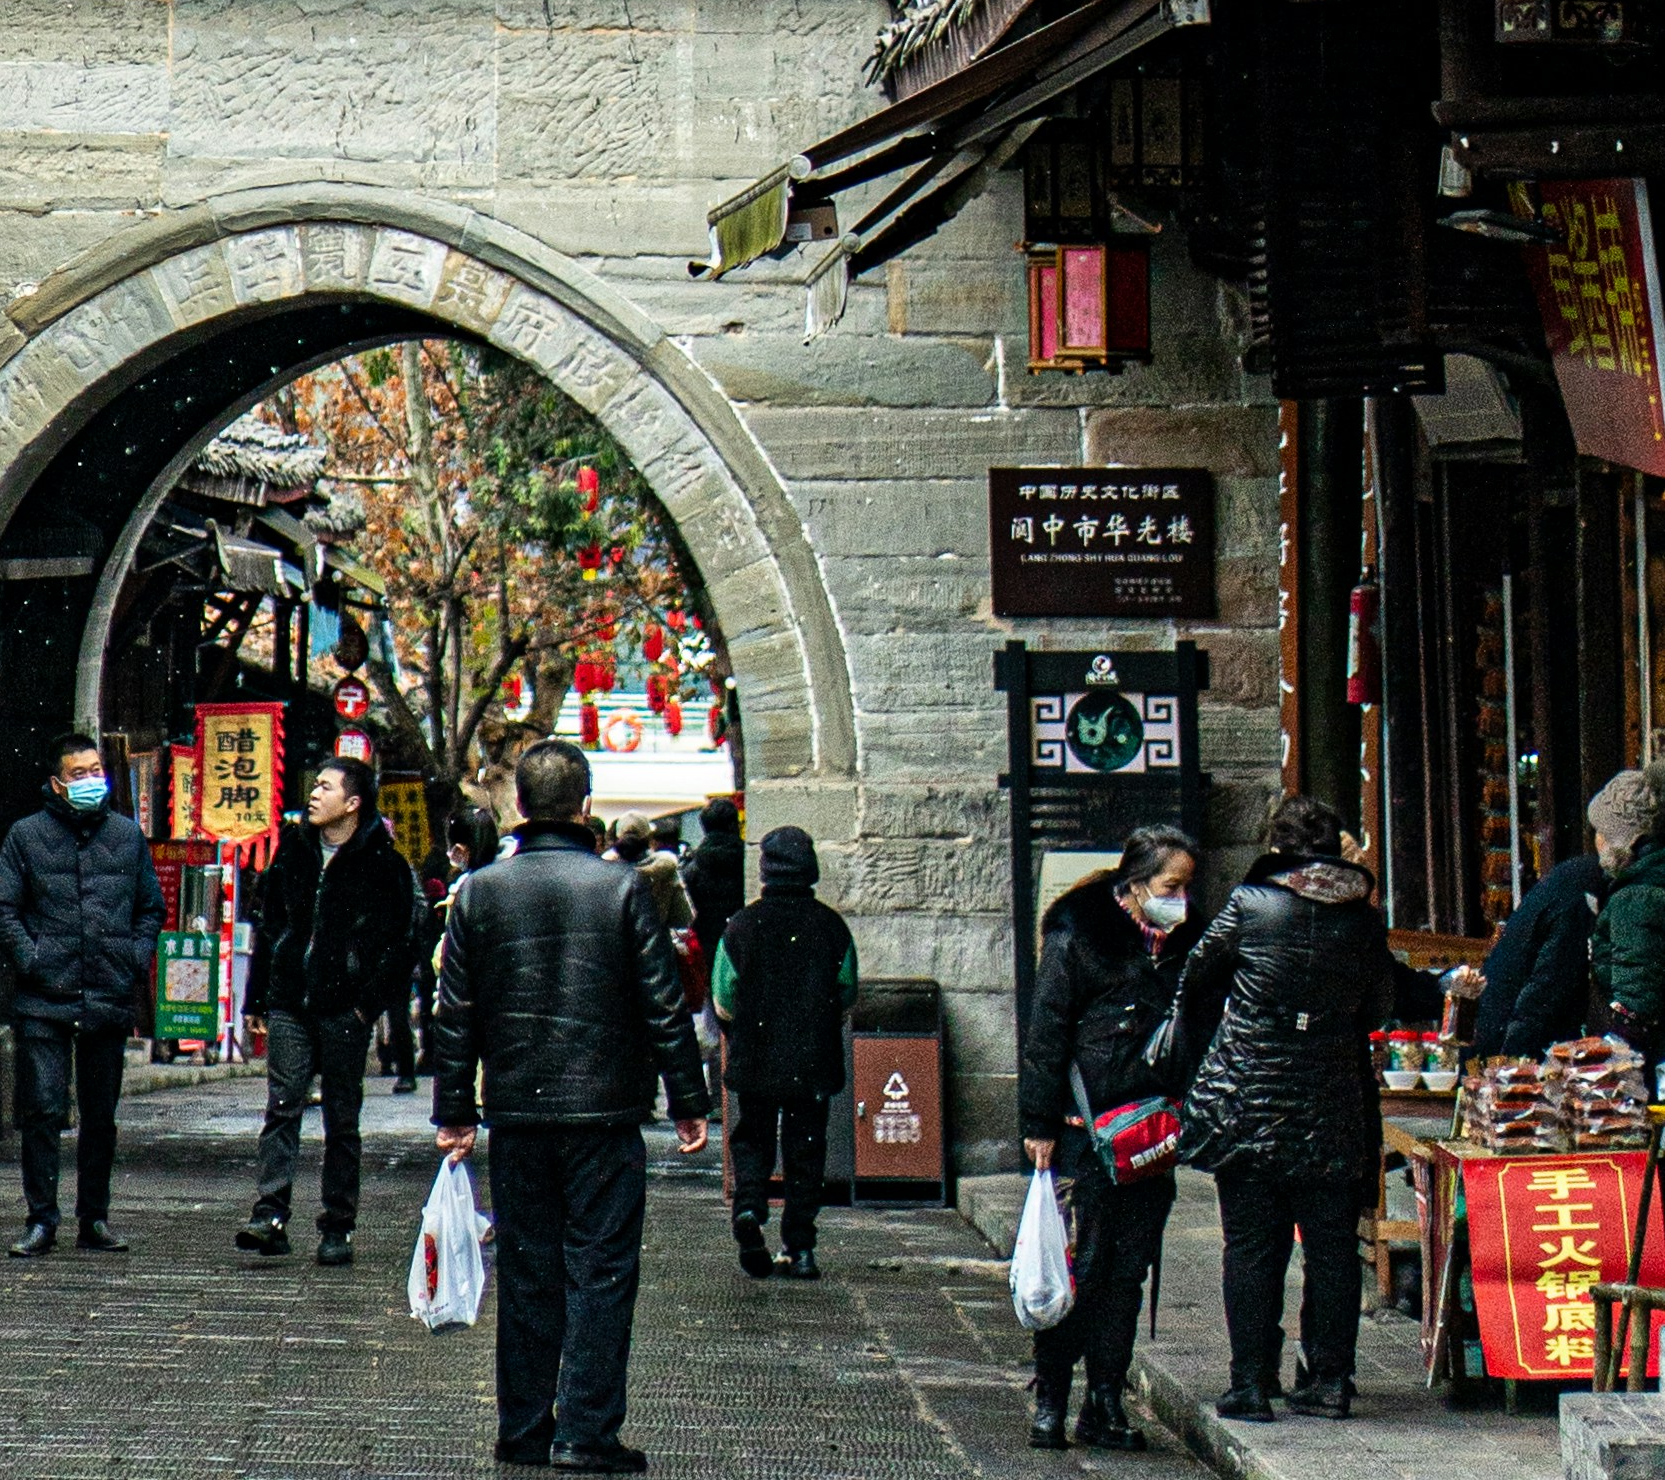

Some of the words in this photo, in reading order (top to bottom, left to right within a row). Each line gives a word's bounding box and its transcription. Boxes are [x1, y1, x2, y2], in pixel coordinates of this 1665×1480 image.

[1019, 484, 1182, 501] 中国历史文化街区
[1011, 513, 1196, 547] 阆中市华光楼
[214, 727, 261, 810] 醋泡脚
[1526, 1167, 1602, 1367] 手工火锅底料
